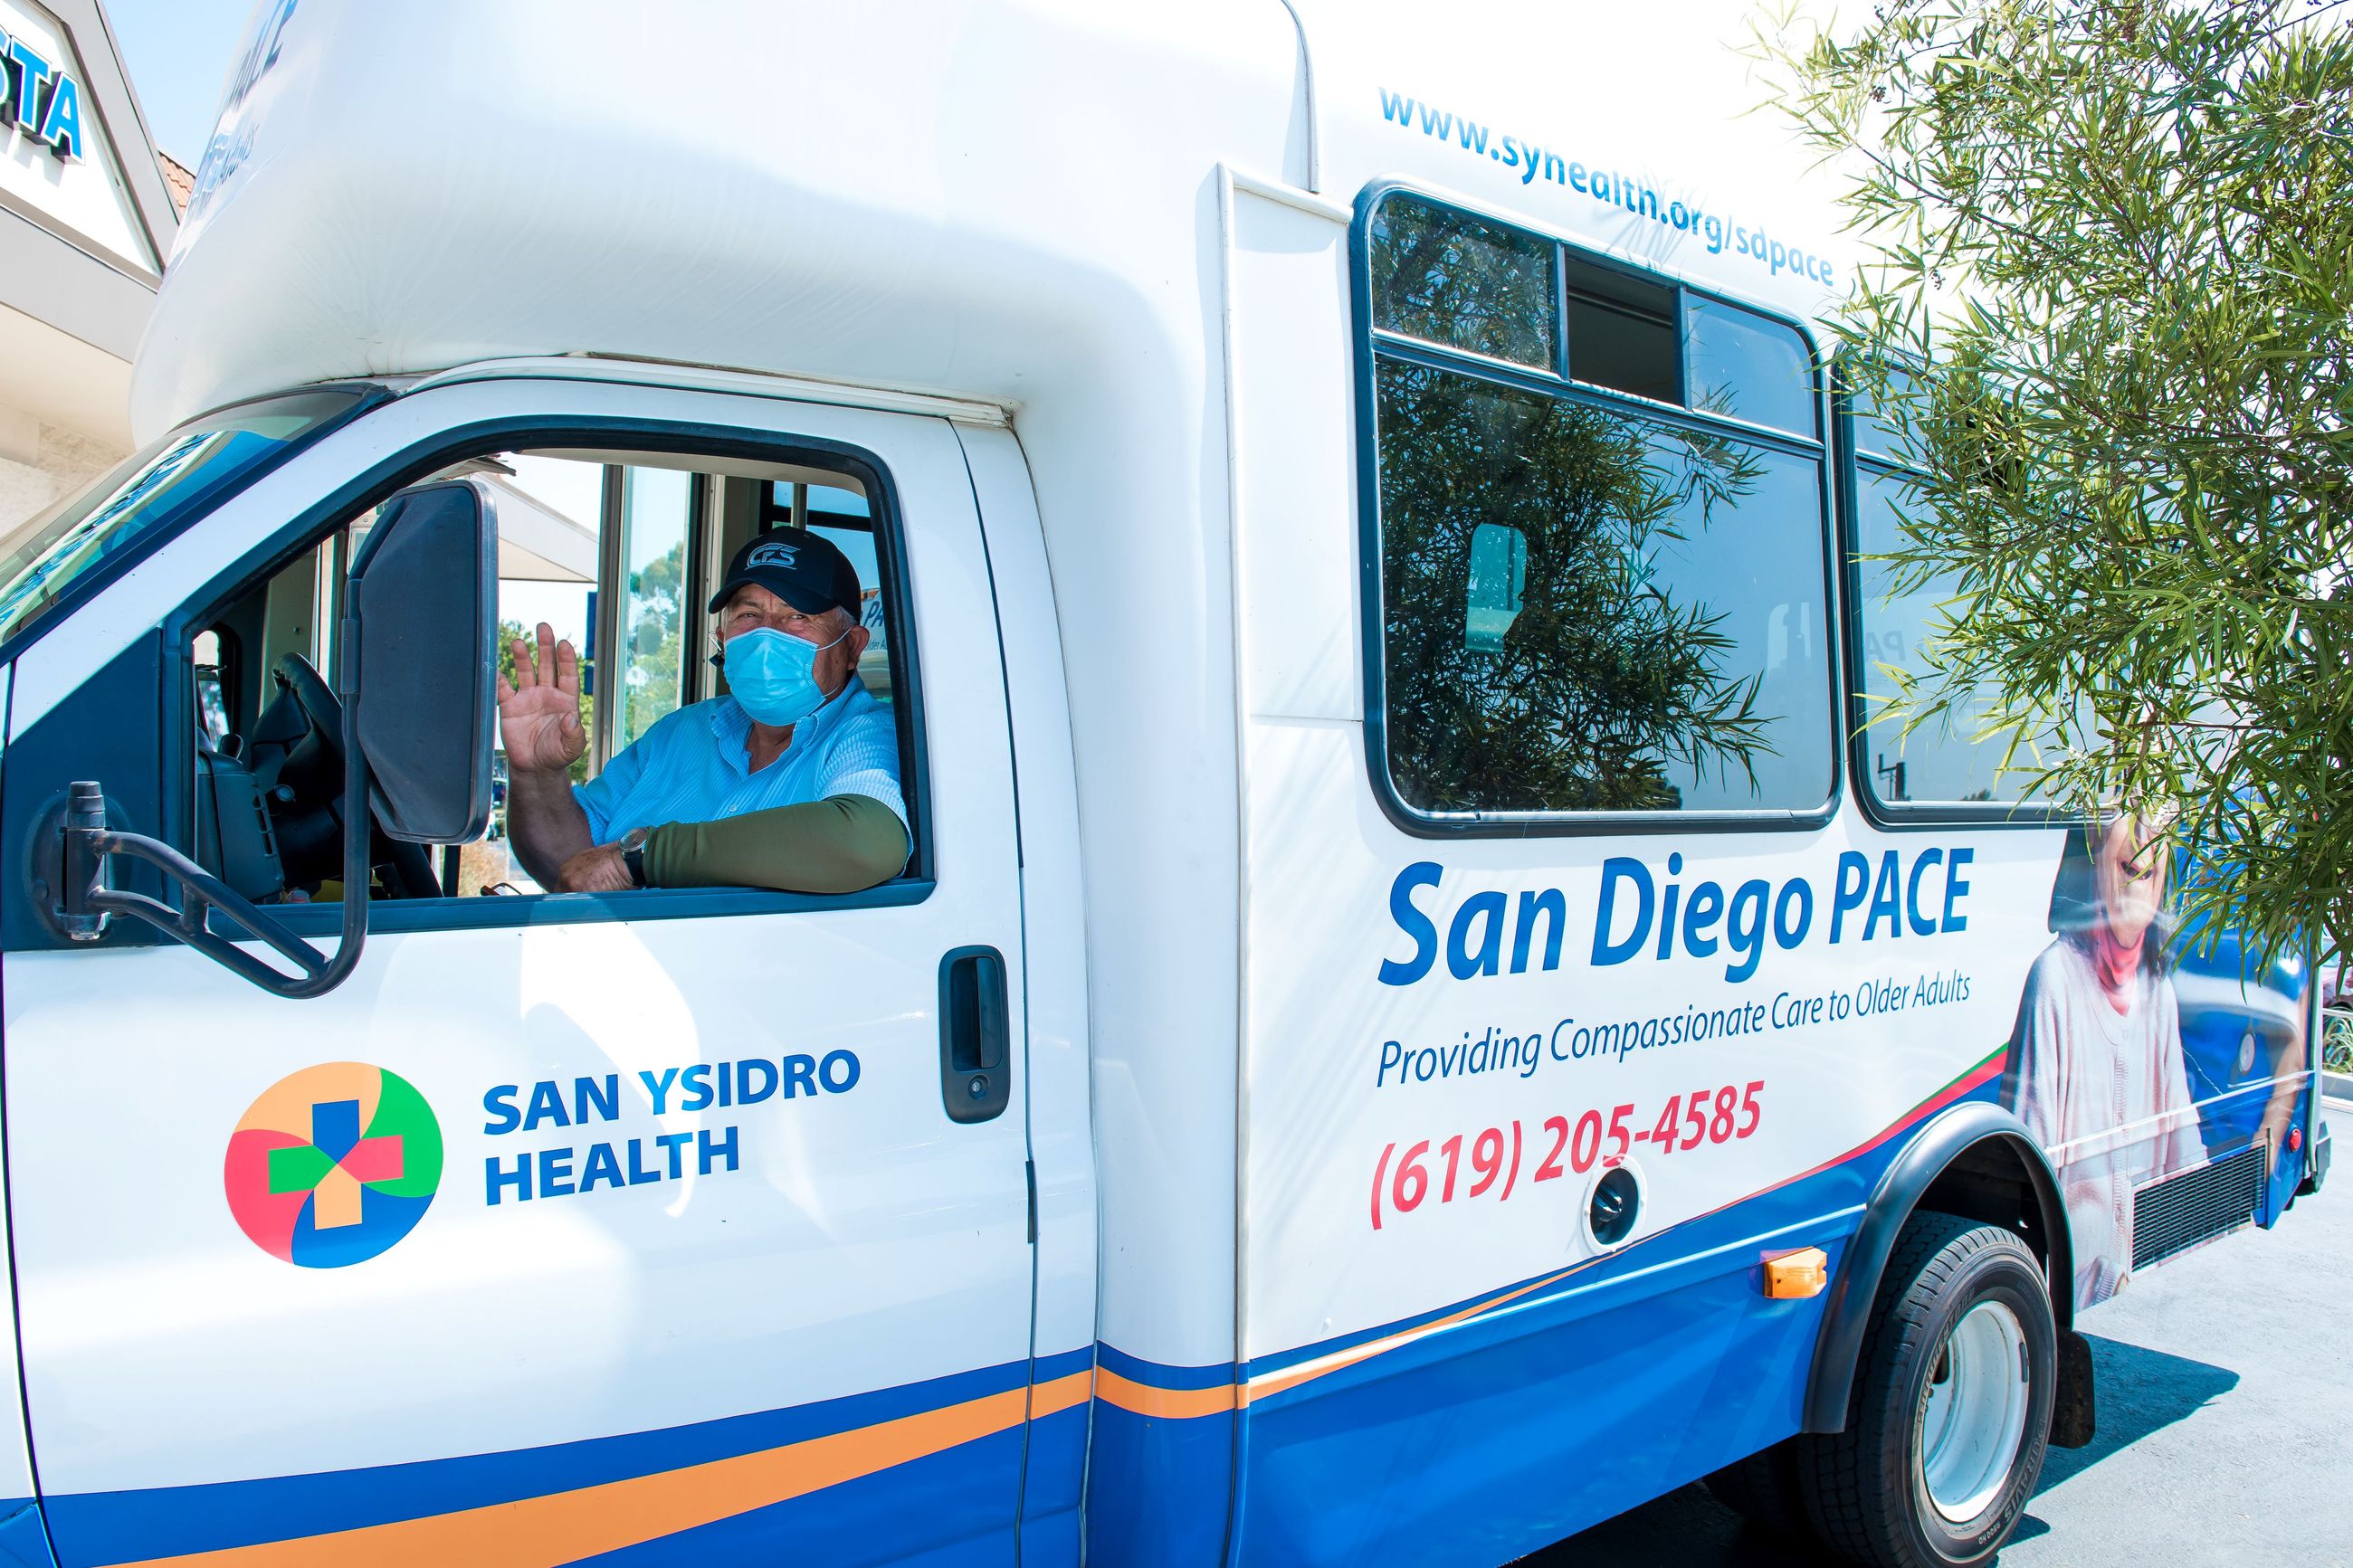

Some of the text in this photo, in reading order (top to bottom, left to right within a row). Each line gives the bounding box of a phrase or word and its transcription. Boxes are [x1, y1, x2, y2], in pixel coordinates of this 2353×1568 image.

[1378, 86, 1834, 288] www.syhealth.org/sdpace
[1377, 848, 1975, 986] San Diego PACE
[1377, 969, 1970, 1087] Providing Compassionate Care to Older Adults
[482, 1049, 861, 1136] SAN YSIDRO
[1370, 1080, 1765, 1231] (619) 205-4585
[485, 1126, 739, 1206] HEALTH
